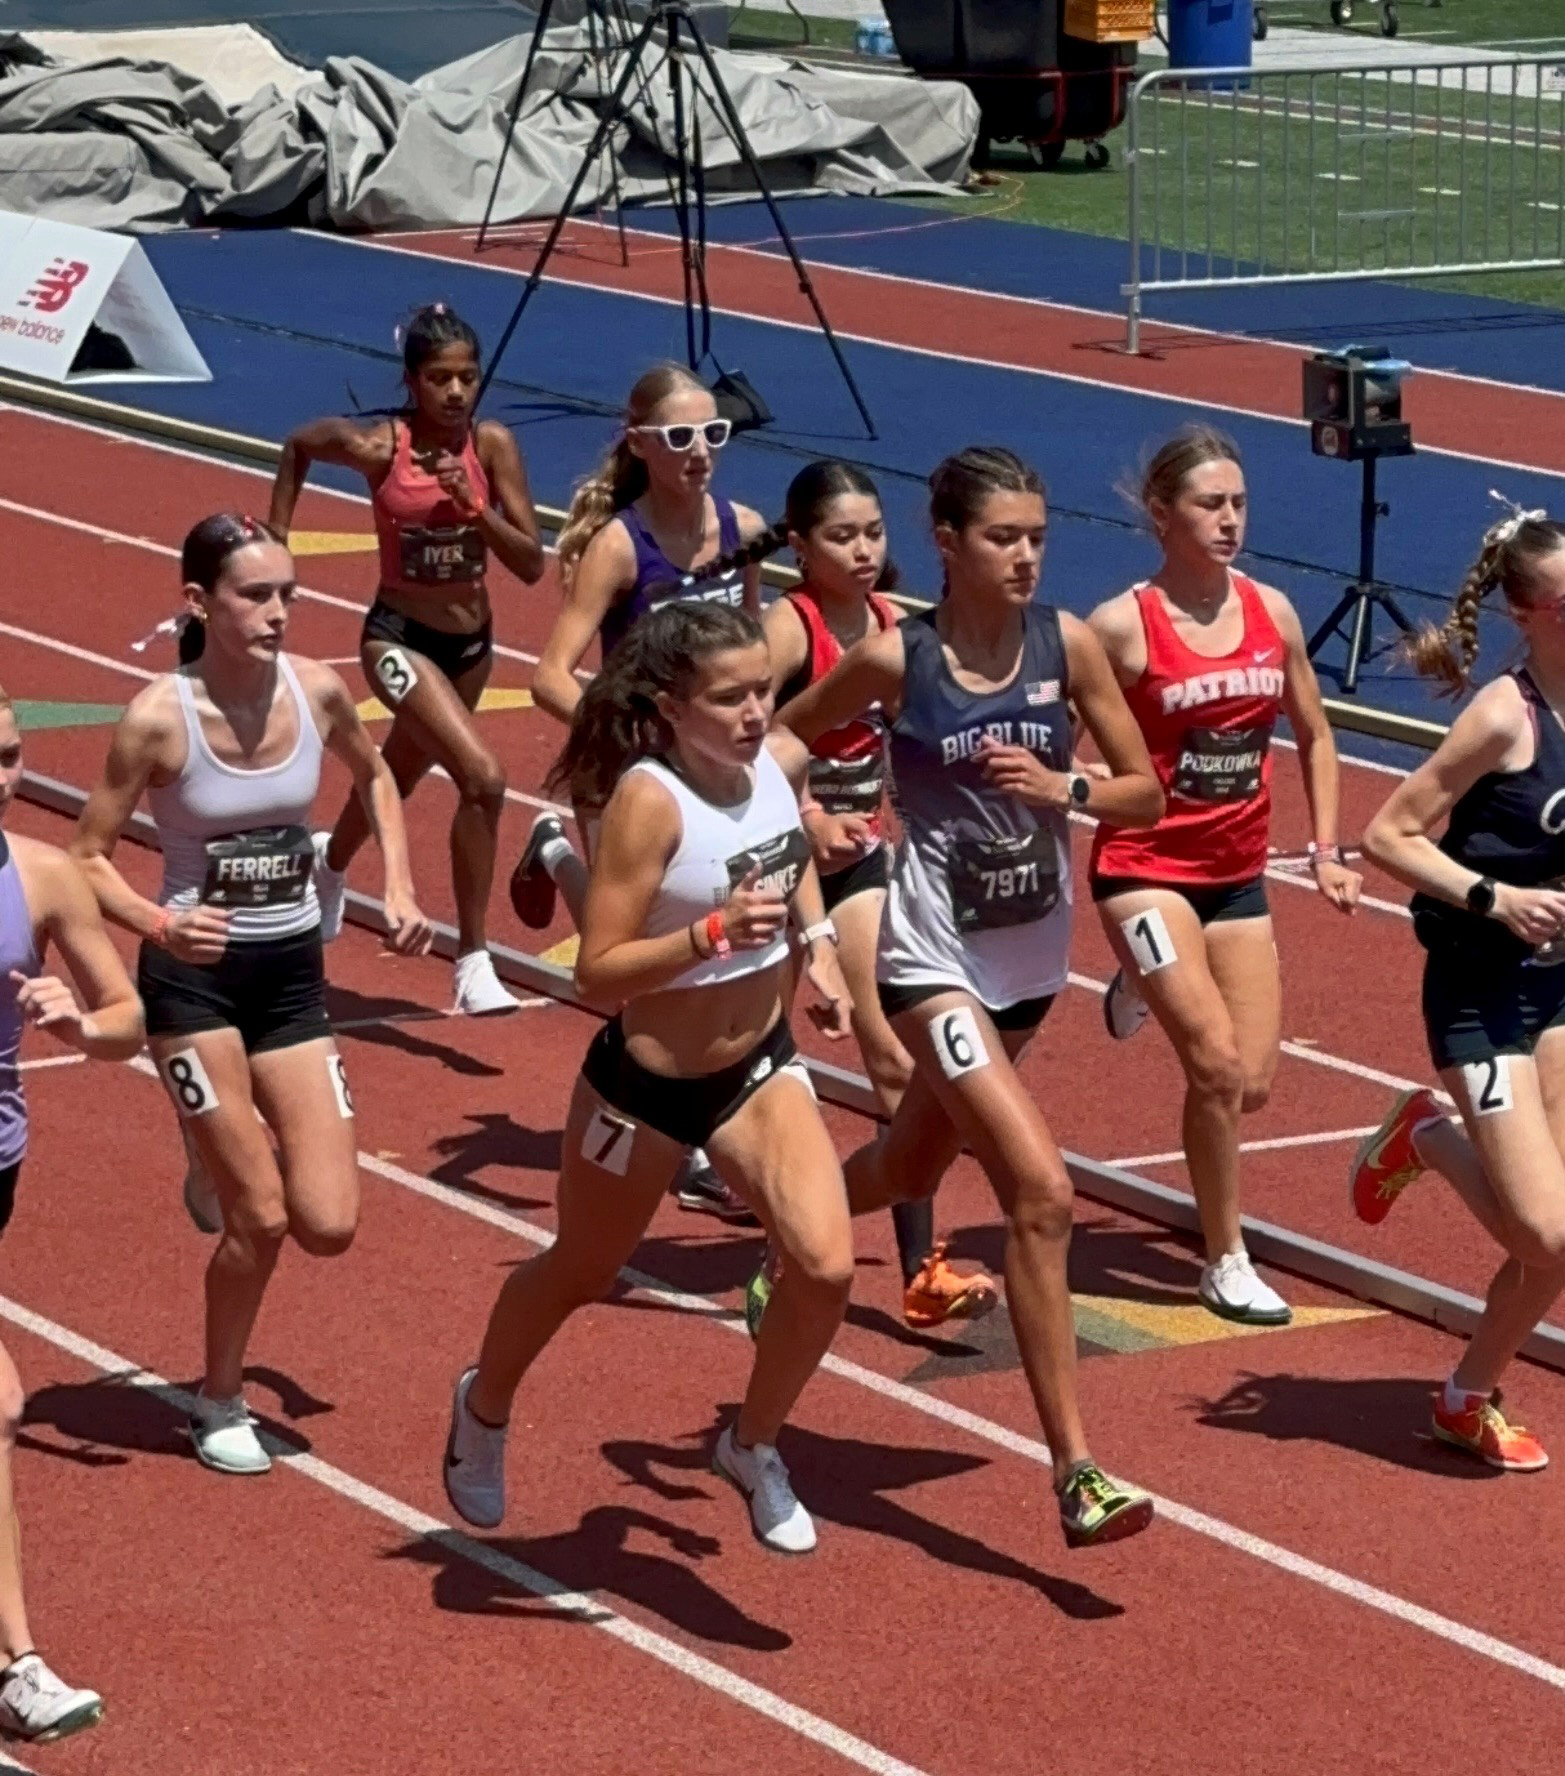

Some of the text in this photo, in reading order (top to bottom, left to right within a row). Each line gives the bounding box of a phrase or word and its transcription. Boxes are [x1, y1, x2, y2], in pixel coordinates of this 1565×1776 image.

[423, 544, 465, 564] IYER
[380, 655, 410, 695] 3
[940, 720, 1053, 767] BIG BLUE
[218, 853, 302, 882] FERRELL
[980, 861, 1039, 901] 7971
[1134, 915, 1163, 965] 1
[943, 1013, 976, 1068] 6
[168, 1055, 206, 1112] 8
[1474, 1058, 1504, 1111] 2
[592, 1111, 626, 1164] 7
